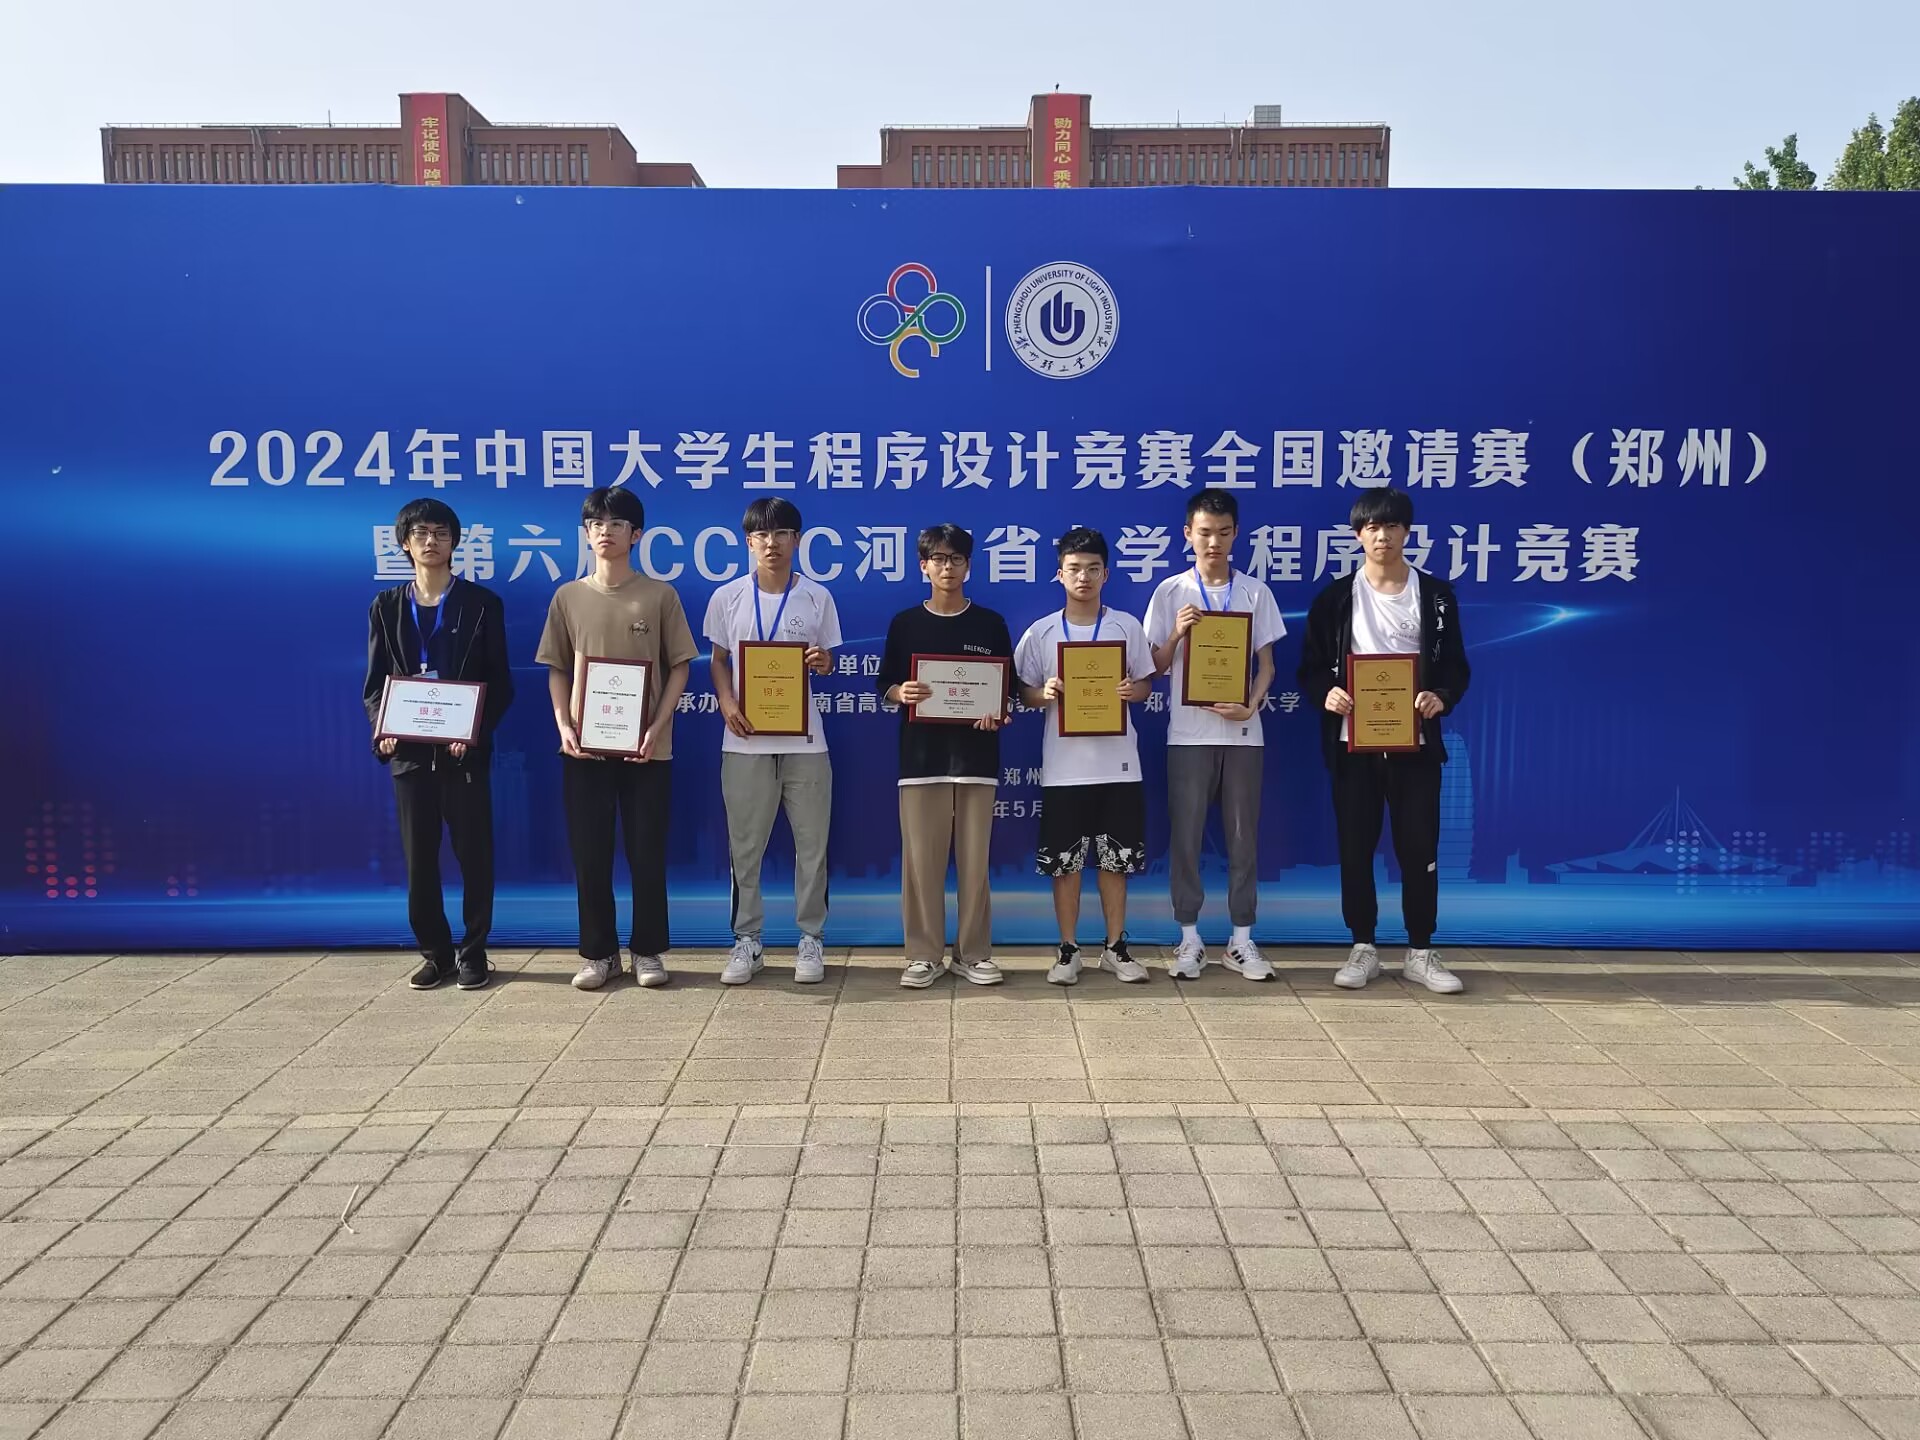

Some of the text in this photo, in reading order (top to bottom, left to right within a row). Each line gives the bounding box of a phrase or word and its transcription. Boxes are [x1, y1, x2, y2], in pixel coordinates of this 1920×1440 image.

[421, 116, 440, 163] 牢记使命
[1014, 270, 1112, 335] ZHENGZHOU UNIVERSITY OF LIGHT INDUSTRY
